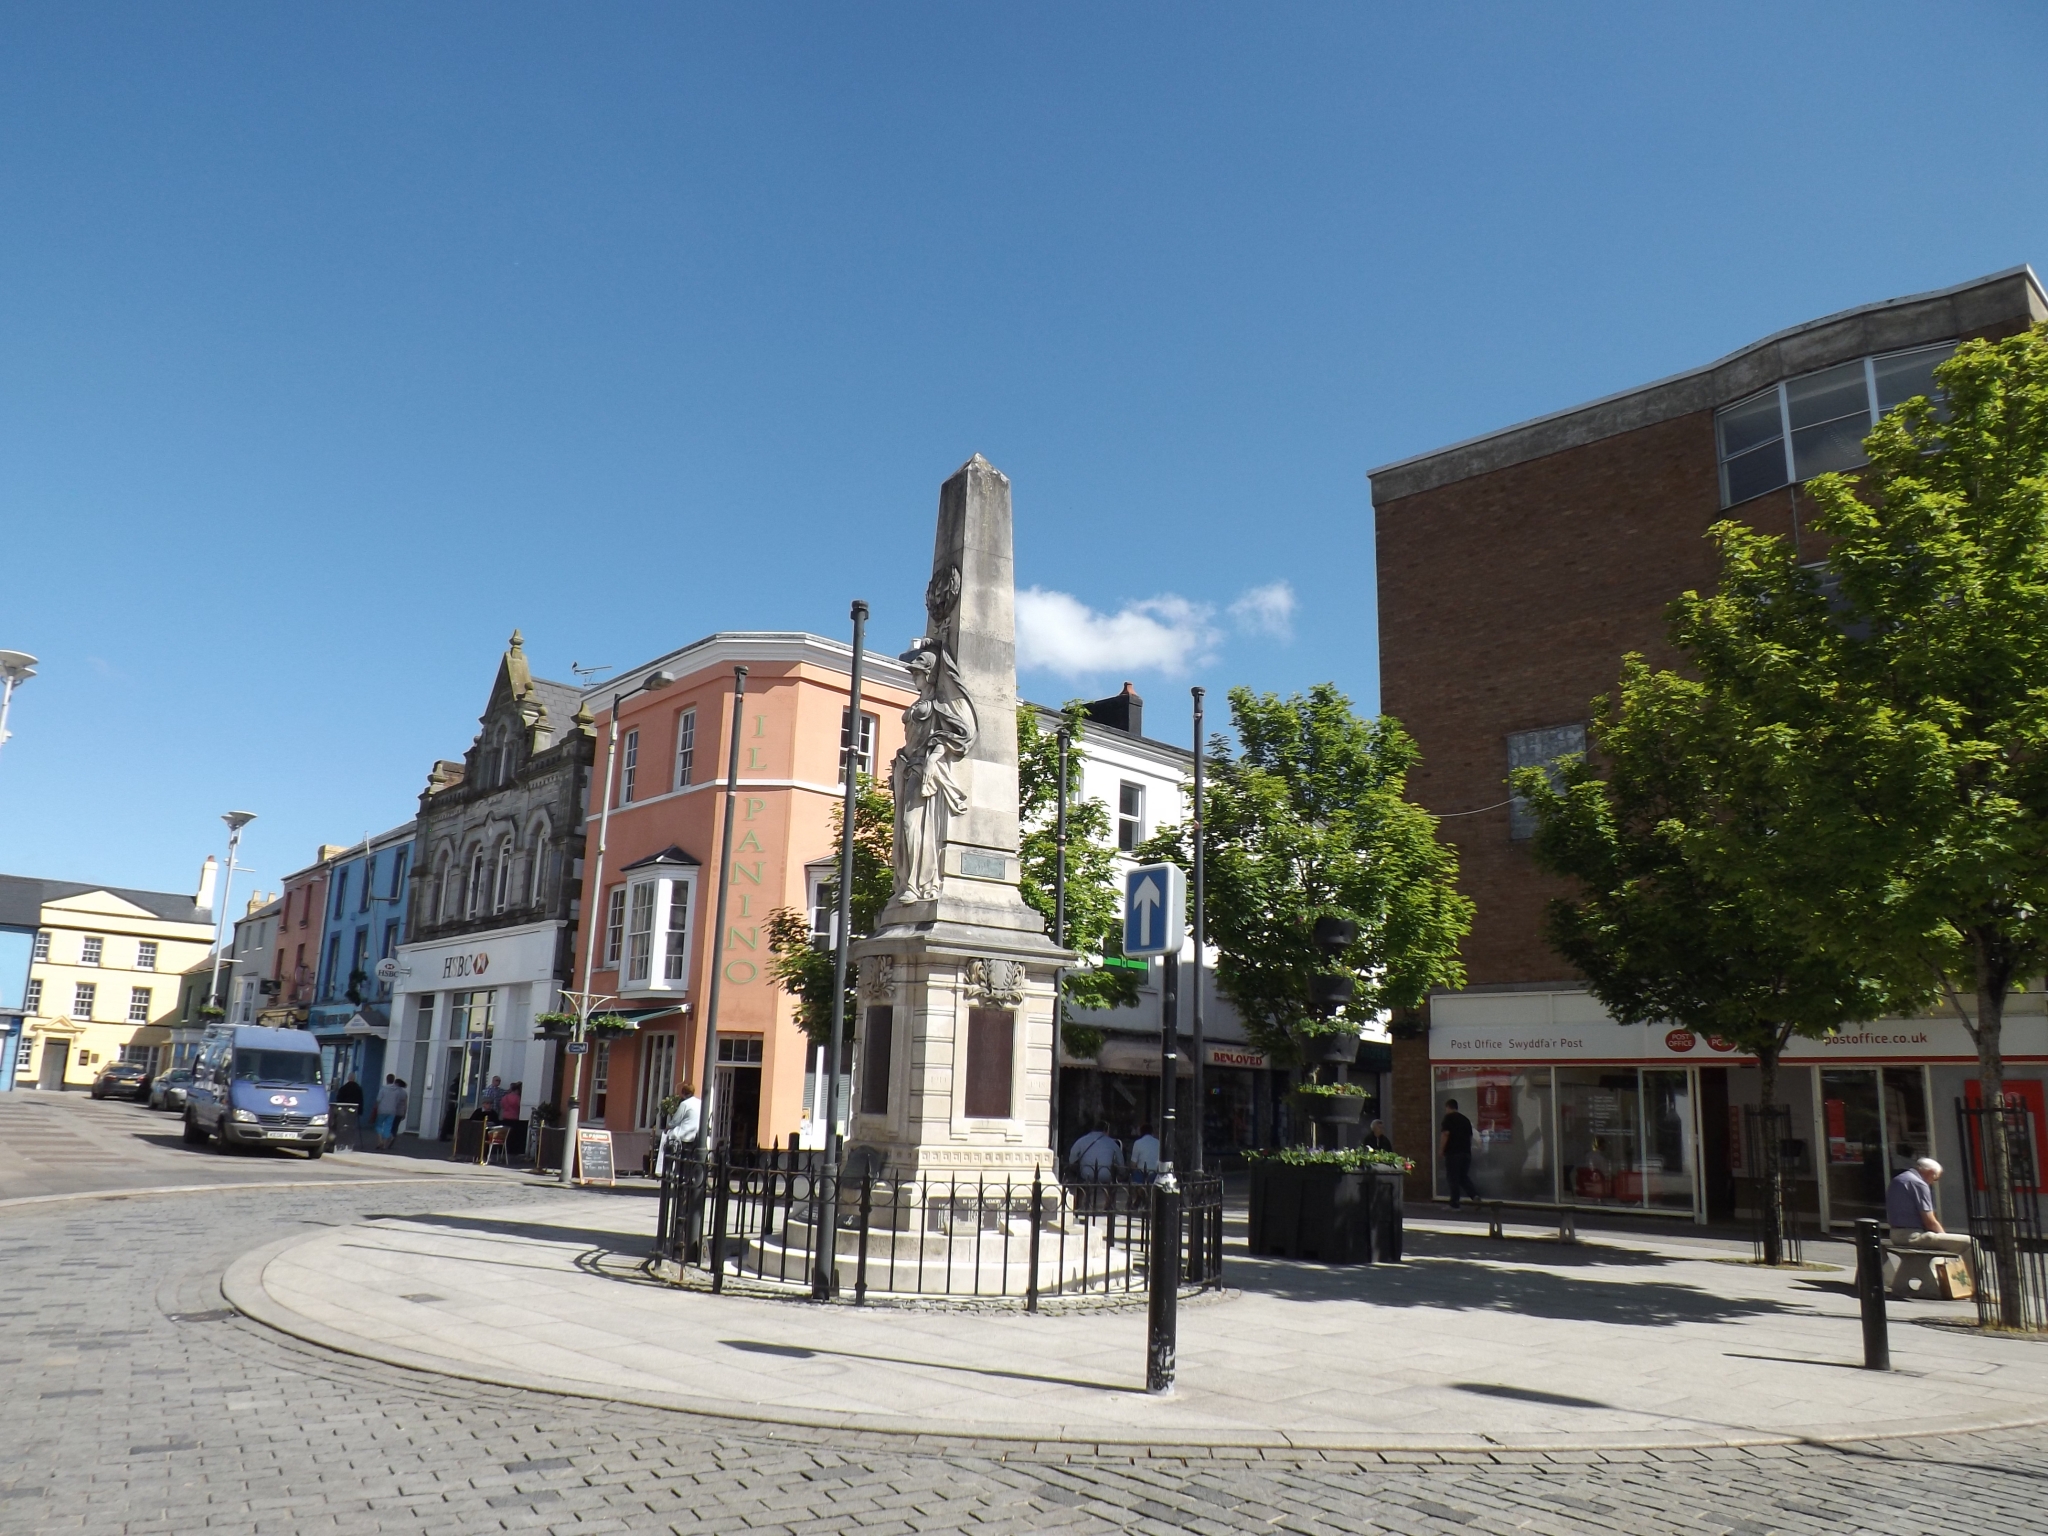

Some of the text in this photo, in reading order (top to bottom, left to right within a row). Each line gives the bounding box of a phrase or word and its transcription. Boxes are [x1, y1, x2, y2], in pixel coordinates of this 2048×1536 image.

[724, 797, 767, 984] PANINO
[378, 969, 399, 978] HSBC
[442, 954, 473, 979] HSBC
[1450, 1039, 1471, 1049] Post
[1474, 1039, 1502, 1049] Office
[1560, 1038, 1583, 1048] Post
[1824, 1032, 1928, 1046] postoffice.co.uk
